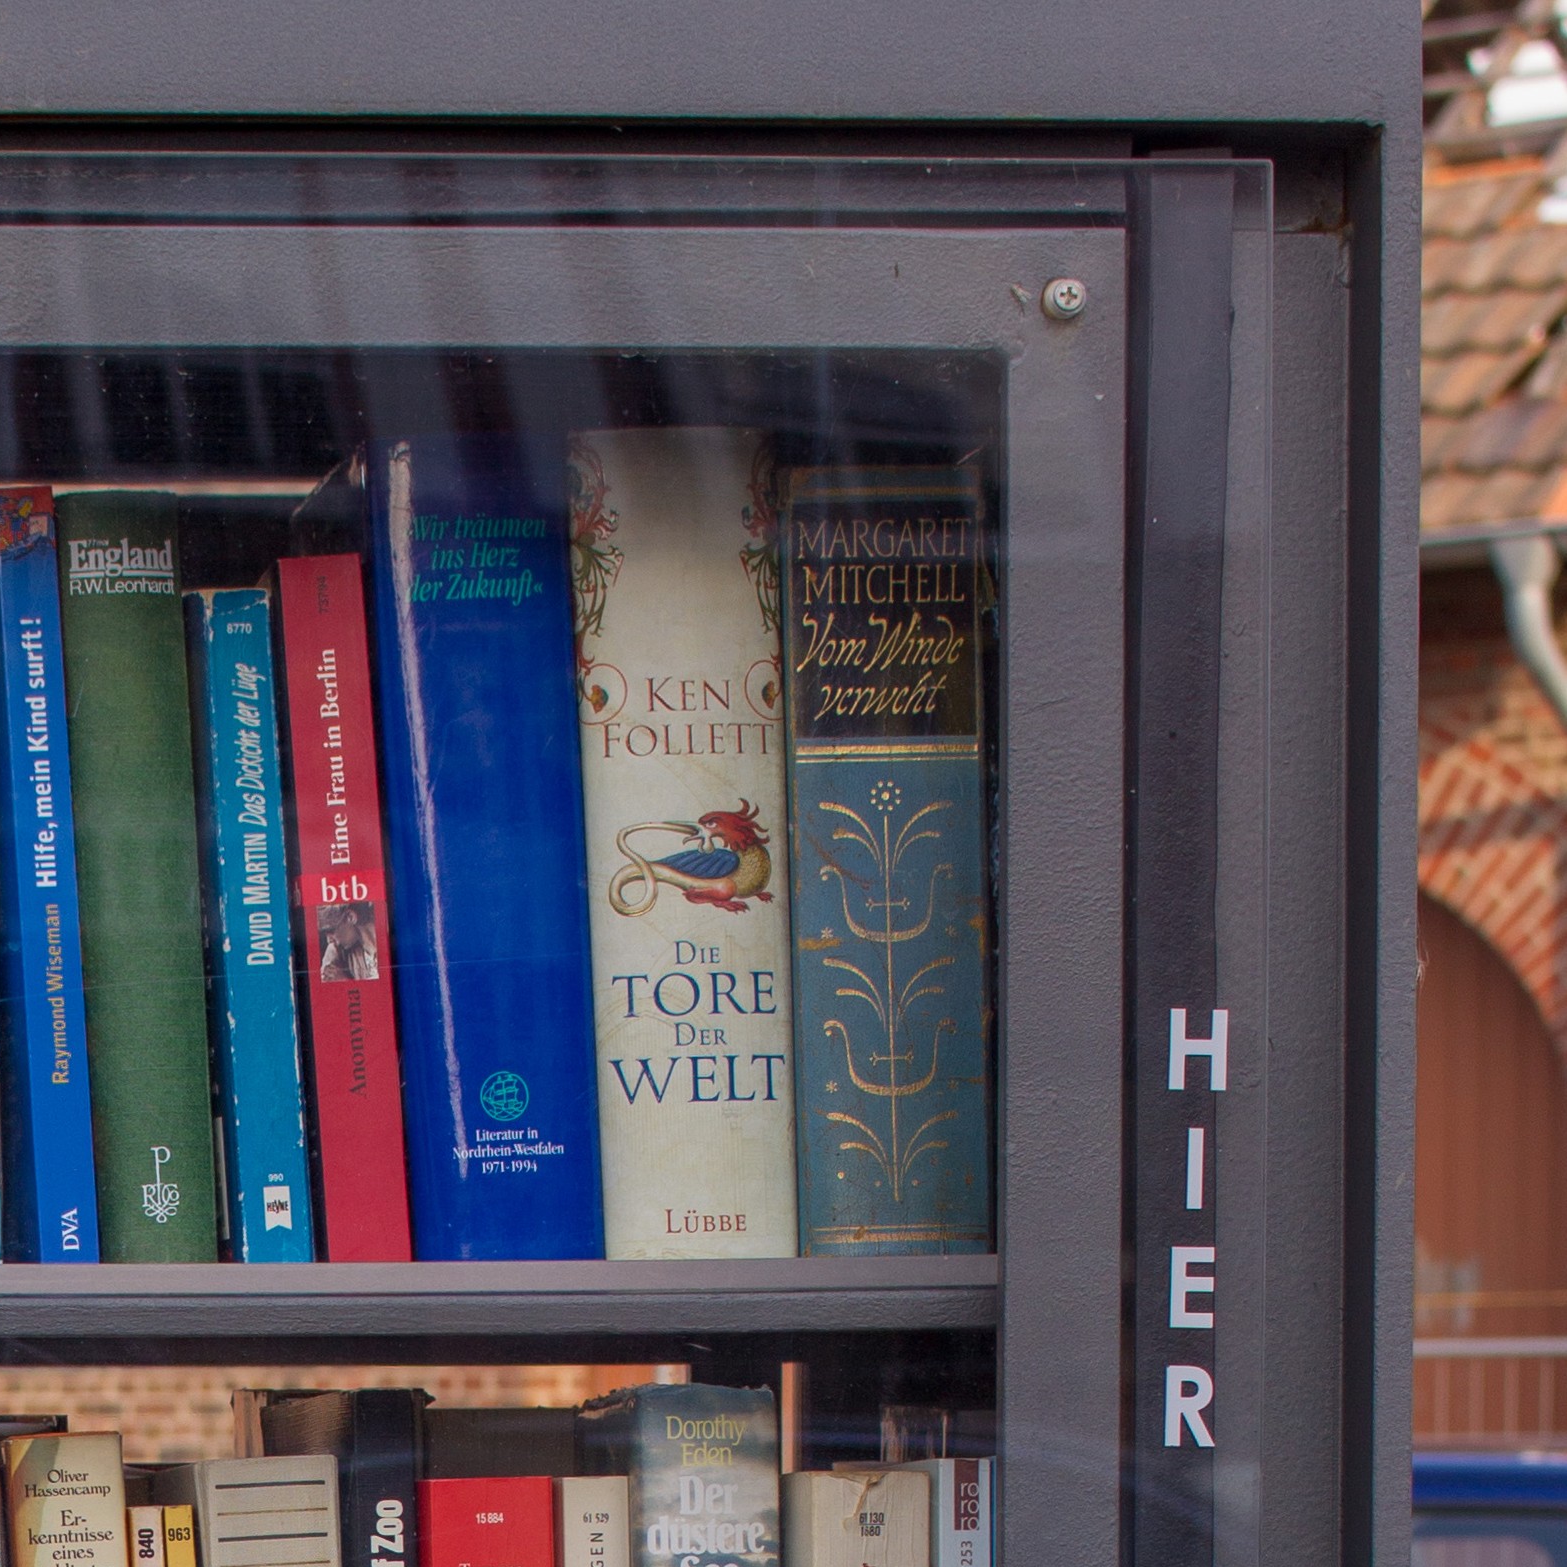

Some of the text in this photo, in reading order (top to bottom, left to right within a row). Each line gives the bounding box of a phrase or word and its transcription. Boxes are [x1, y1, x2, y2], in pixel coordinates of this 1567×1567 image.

[798, 518, 972, 559] MARGARET
[69, 538, 174, 578] England
[106, 575, 175, 596] Leonhardt
[803, 564, 965, 604] MITCHELL
[227, 624, 252, 634] 8770
[797, 612, 964, 673] Vom Winde
[646, 677, 730, 713] KEN
[814, 671, 947, 721] verweht
[603, 723, 774, 758] FOLLETT
[321, 876, 368, 903] btb
[45, 904, 69, 1084] Raymond Wiseman
[612, 971, 777, 1018] TORE
[348, 988, 366, 1097] Anonyma
[608, 1054, 785, 1105] WELT
[475, 1128, 524, 1142] Literatur
[481, 1161, 537, 1174] 1971-1994
[62, 1208, 80, 1251] DVA
[665, 1208, 747, 1234] LÜBBE
[1164, 1007, 1229, 1448] HIER
[25, 1484, 111, 1500] Hassencamp
[47, 1469, 89, 1484] Oliver
[60, 1510, 87, 1526] Er-
[28, 1528, 114, 1546] kenntnisse
[52, 1547, 94, 1561] eines
